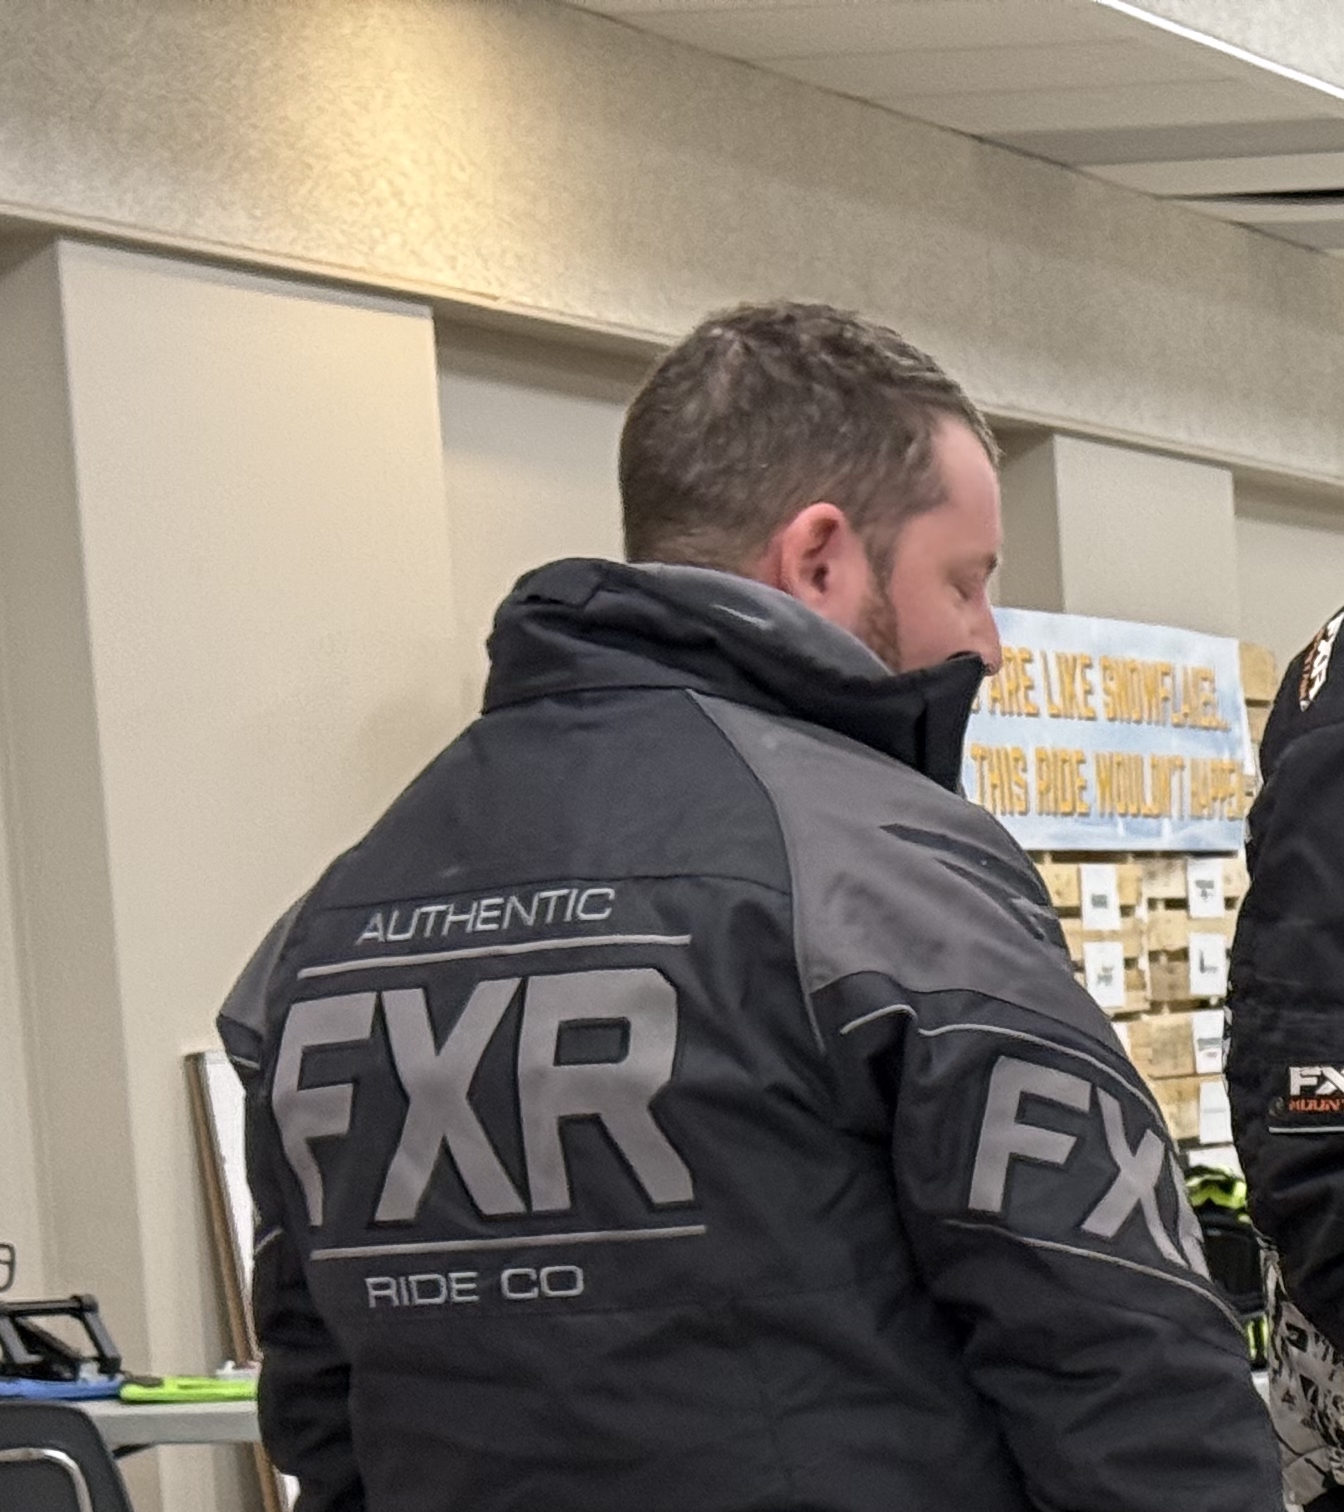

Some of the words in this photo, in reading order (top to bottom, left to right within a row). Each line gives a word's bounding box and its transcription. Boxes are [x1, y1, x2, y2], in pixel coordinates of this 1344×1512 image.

[1040, 649, 1096, 721] LIKE
[971, 742, 1029, 817] THIS
[1035, 746, 1091, 817] RIDE
[354, 887, 617, 947] AUTHENTIC
[271, 967, 695, 1228] FXR
[366, 1270, 480, 1309] RIDE
[500, 1264, 586, 1302] CO
